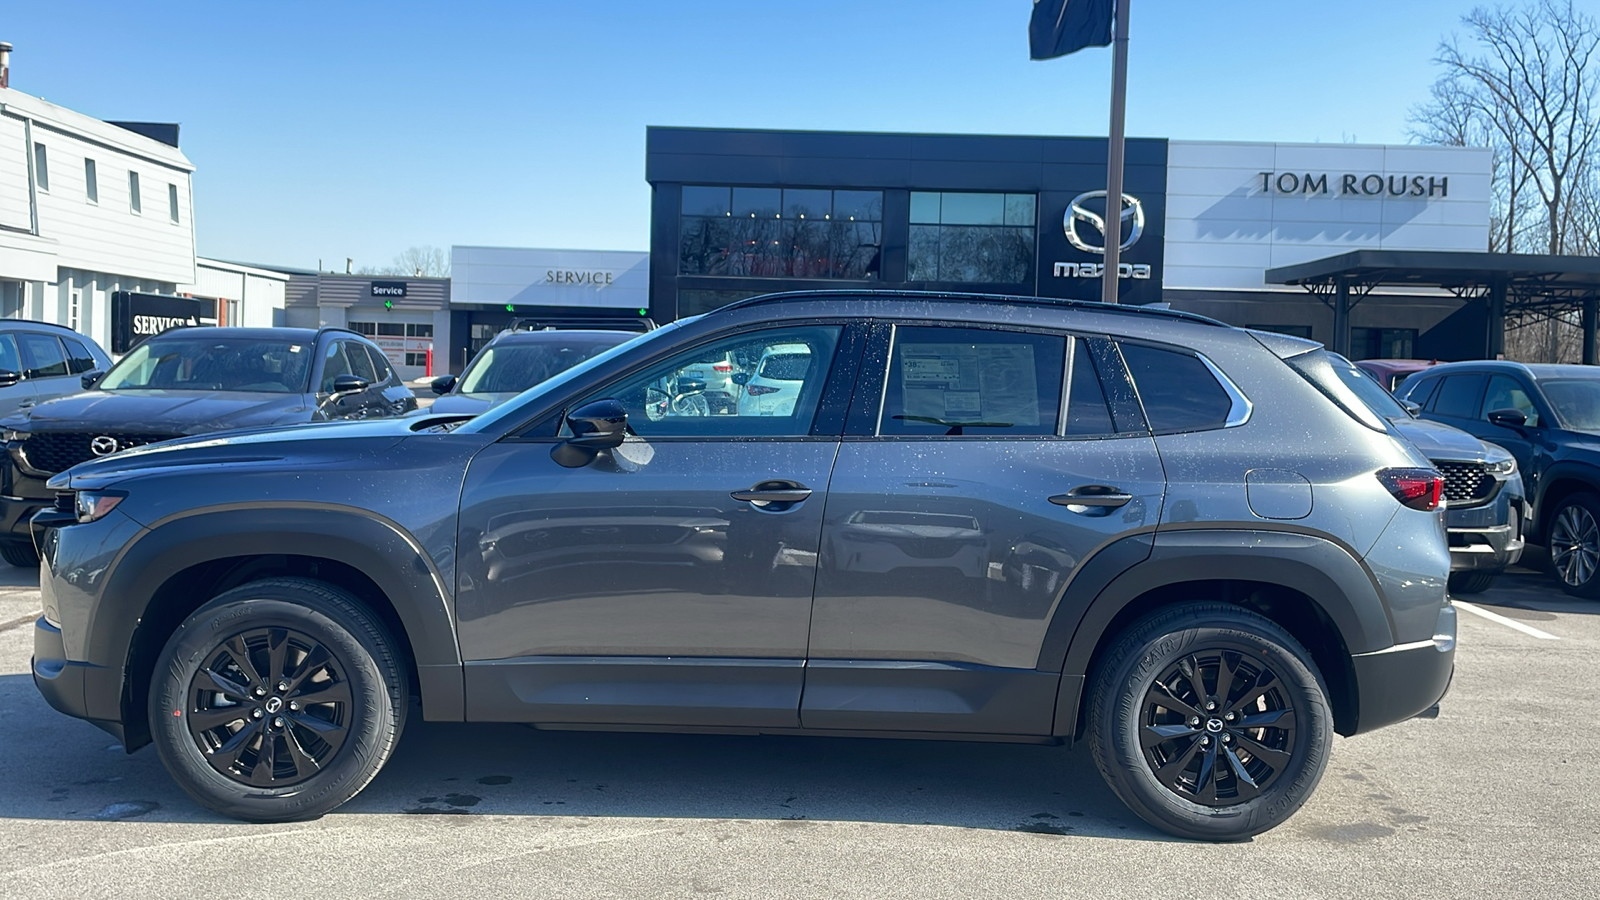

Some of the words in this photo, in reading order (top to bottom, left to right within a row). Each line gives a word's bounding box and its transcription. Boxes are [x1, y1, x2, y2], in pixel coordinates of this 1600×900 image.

[1259, 172, 1328, 194] TOM
[1342, 174, 1449, 197] ROUSH
[546, 270, 613, 285] SERVICE
[373, 286, 403, 295] Service
